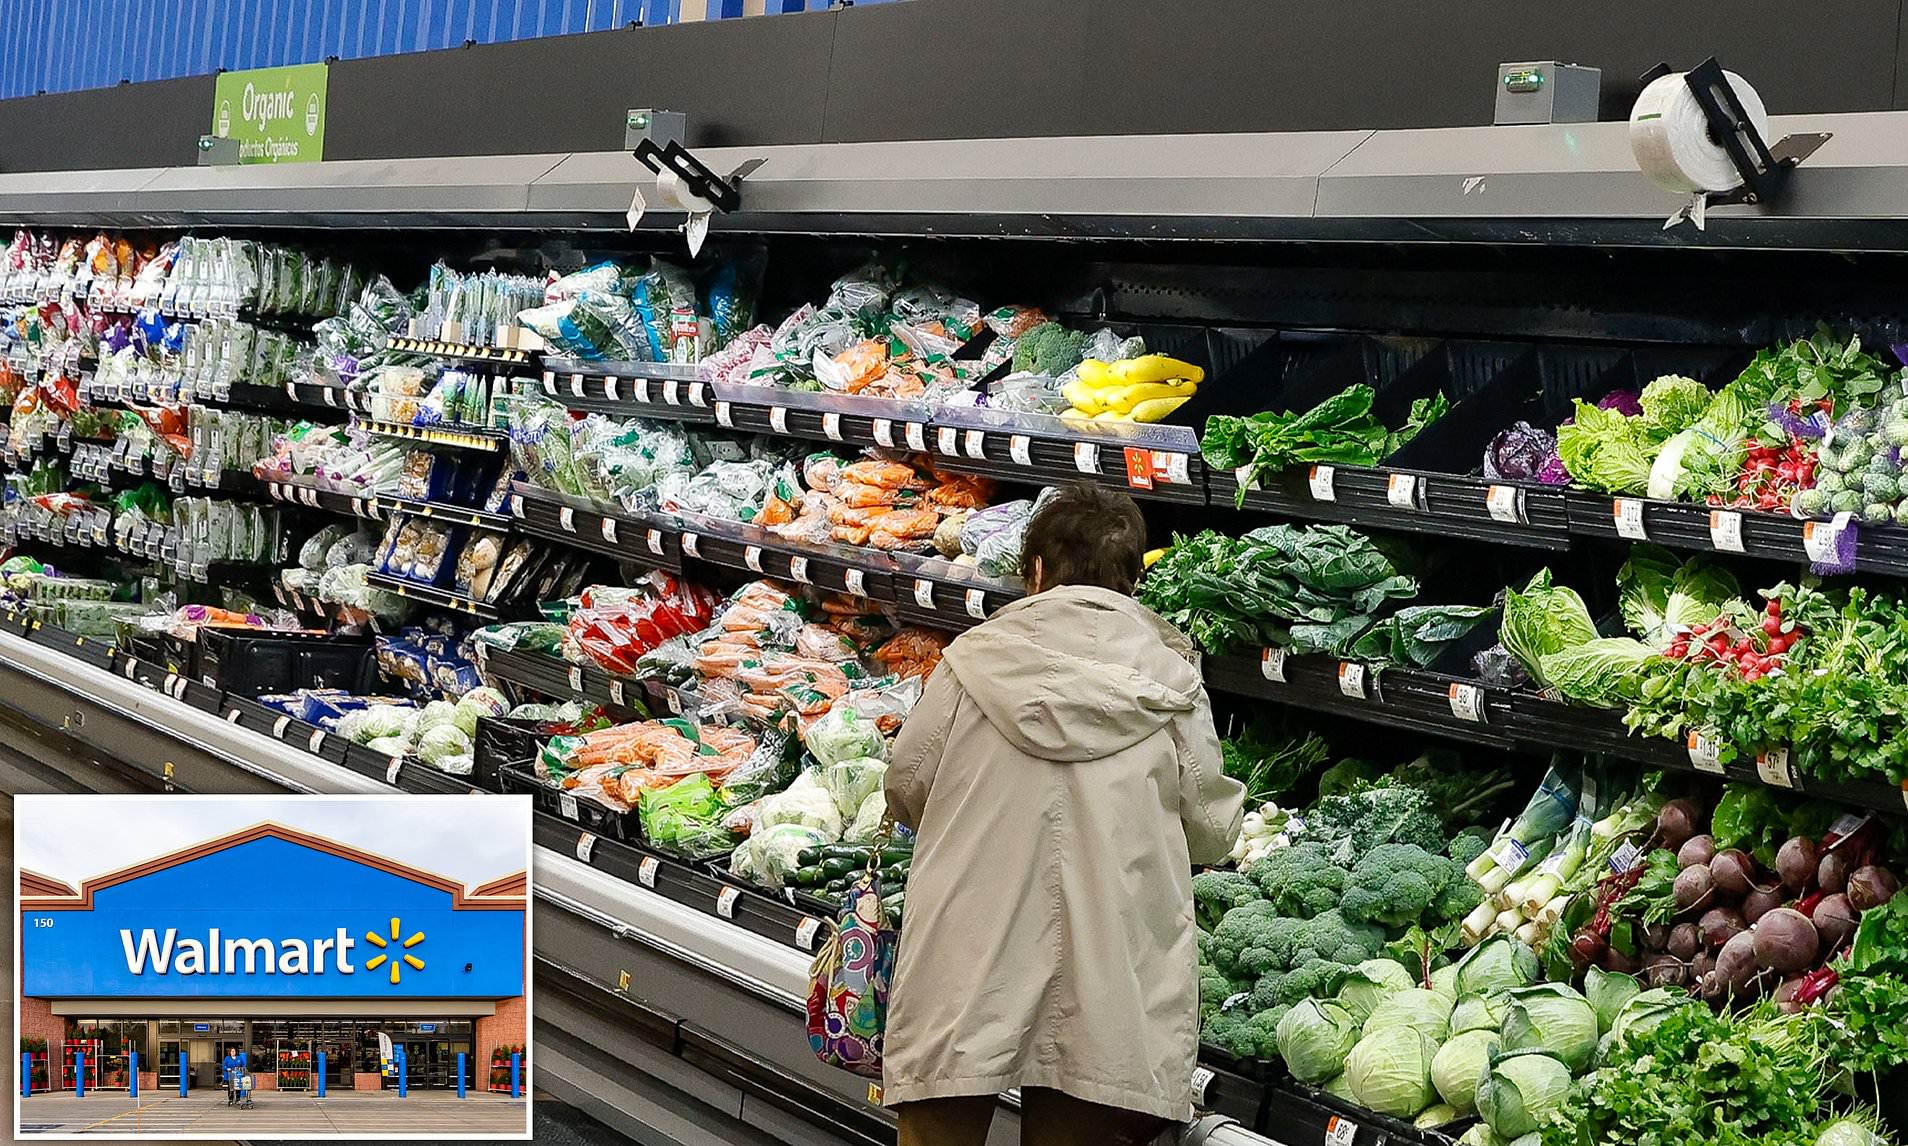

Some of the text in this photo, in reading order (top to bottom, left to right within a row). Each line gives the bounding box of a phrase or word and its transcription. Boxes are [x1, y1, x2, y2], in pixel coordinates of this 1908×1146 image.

[243, 81, 294, 132] Organic
[240, 136, 298, 162] oductos Orgánicos
[33, 918, 54, 928] 150
[119, 927, 355, 975] Walmart
